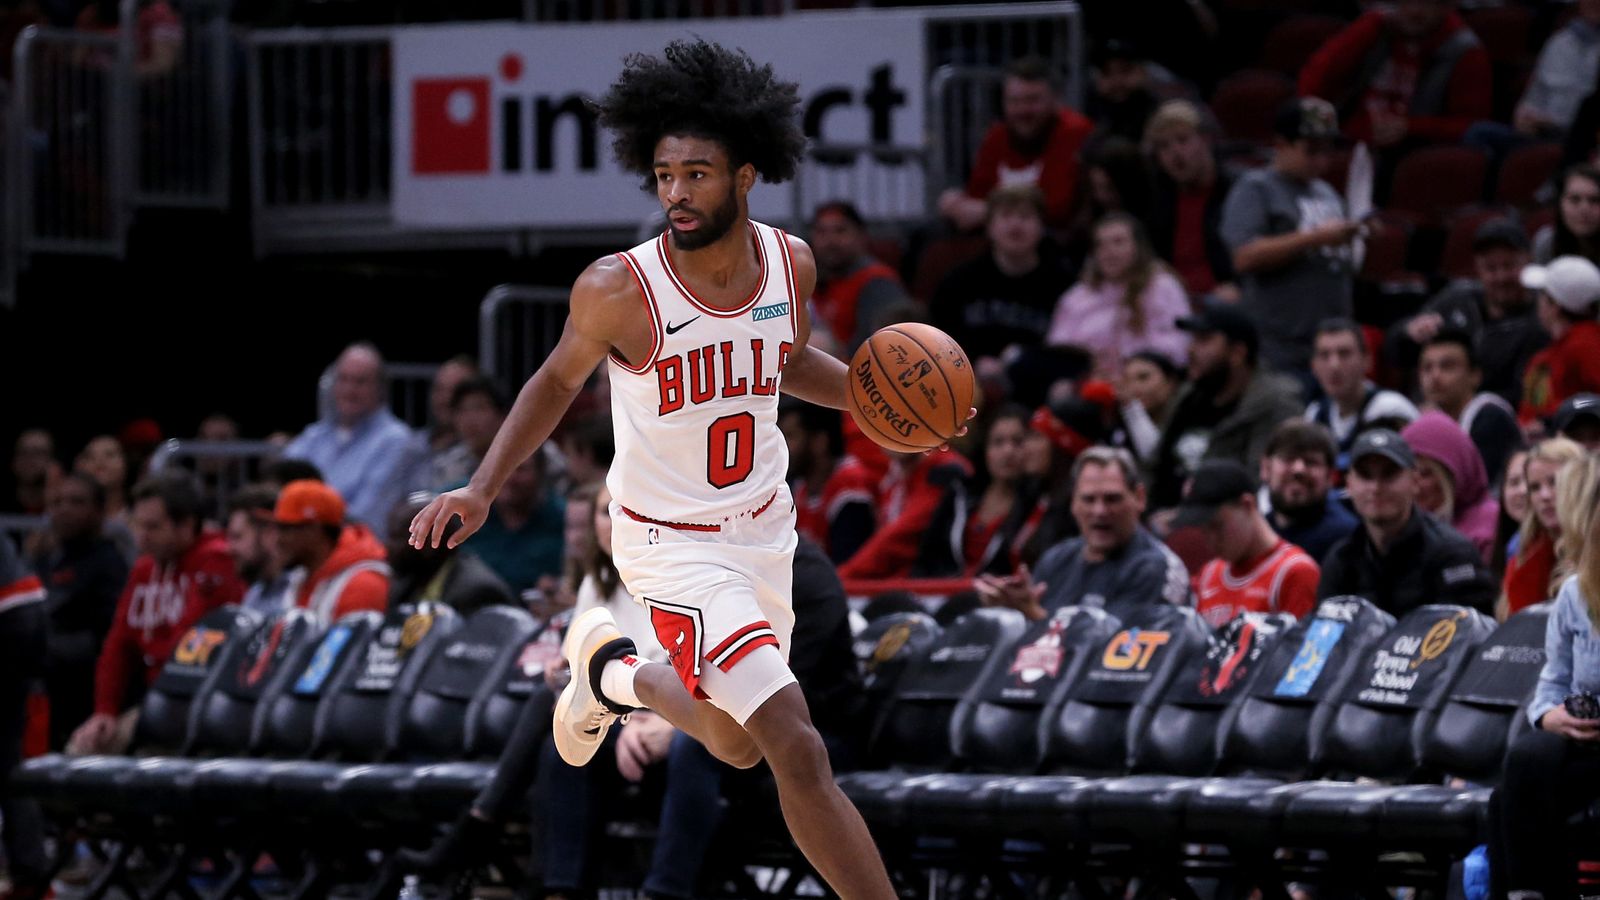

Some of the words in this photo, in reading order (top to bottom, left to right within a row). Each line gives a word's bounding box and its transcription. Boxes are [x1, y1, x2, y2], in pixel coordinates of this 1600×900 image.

[856, 359, 919, 438] SPALDING
[707, 411, 755, 490] 0
[1393, 635, 1421, 655] Old
